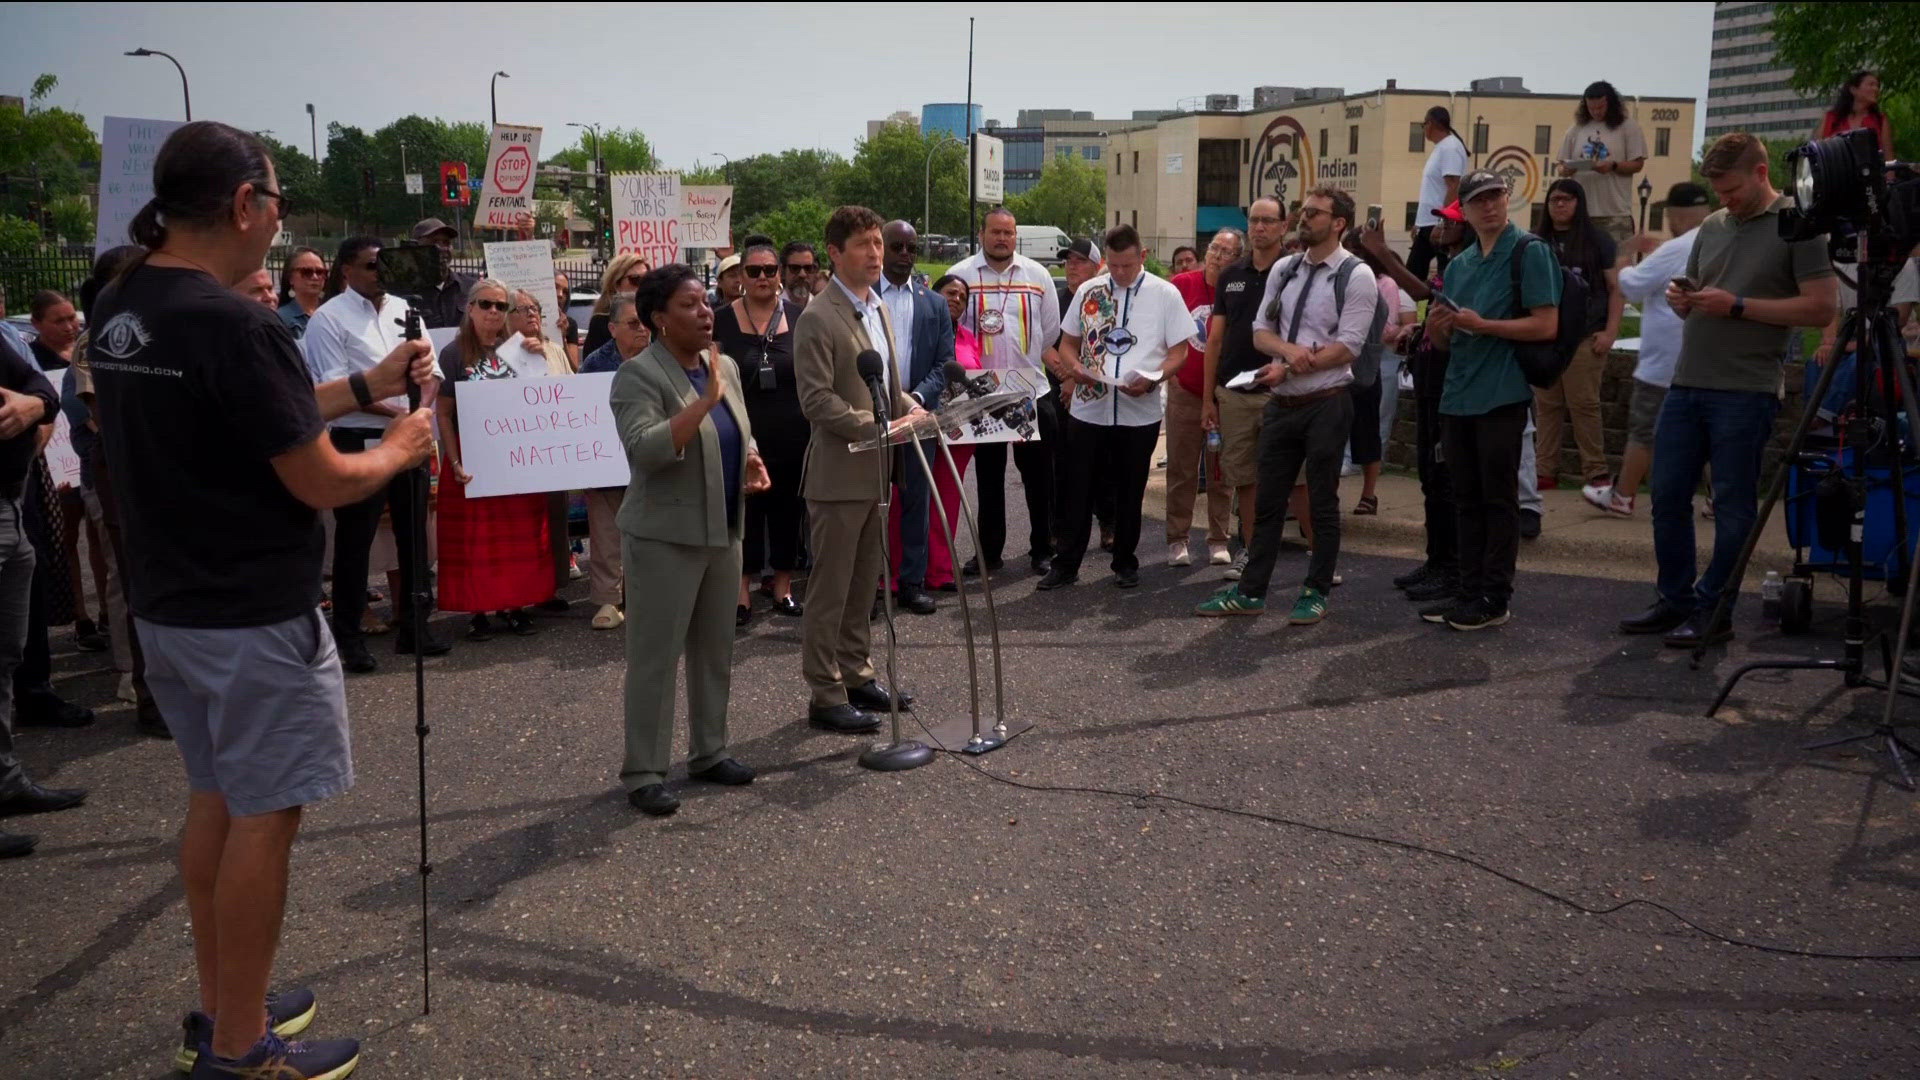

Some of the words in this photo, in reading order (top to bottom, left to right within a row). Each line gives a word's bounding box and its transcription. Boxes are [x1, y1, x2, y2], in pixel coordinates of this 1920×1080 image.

[1651, 108, 1680, 121] 2020
[500, 132, 518, 142] HELP
[522, 133, 532, 143] US
[500, 158, 527, 171] STOP
[1317, 157, 1358, 179] Indian
[618, 176, 657, 198] YOUR
[658, 175, 675, 197] #1
[488, 211, 522, 225] KILLS
[629, 199, 653, 216] JOB
[654, 199, 667, 217] IS
[618, 219, 678, 245] PUBLIC
[681, 222, 718, 242] TTERS
[618, 245, 678, 269] FETY
[523, 383, 575, 406] OUR
[484, 405, 598, 436] CHILDREN
[509, 441, 613, 468] MATTER
